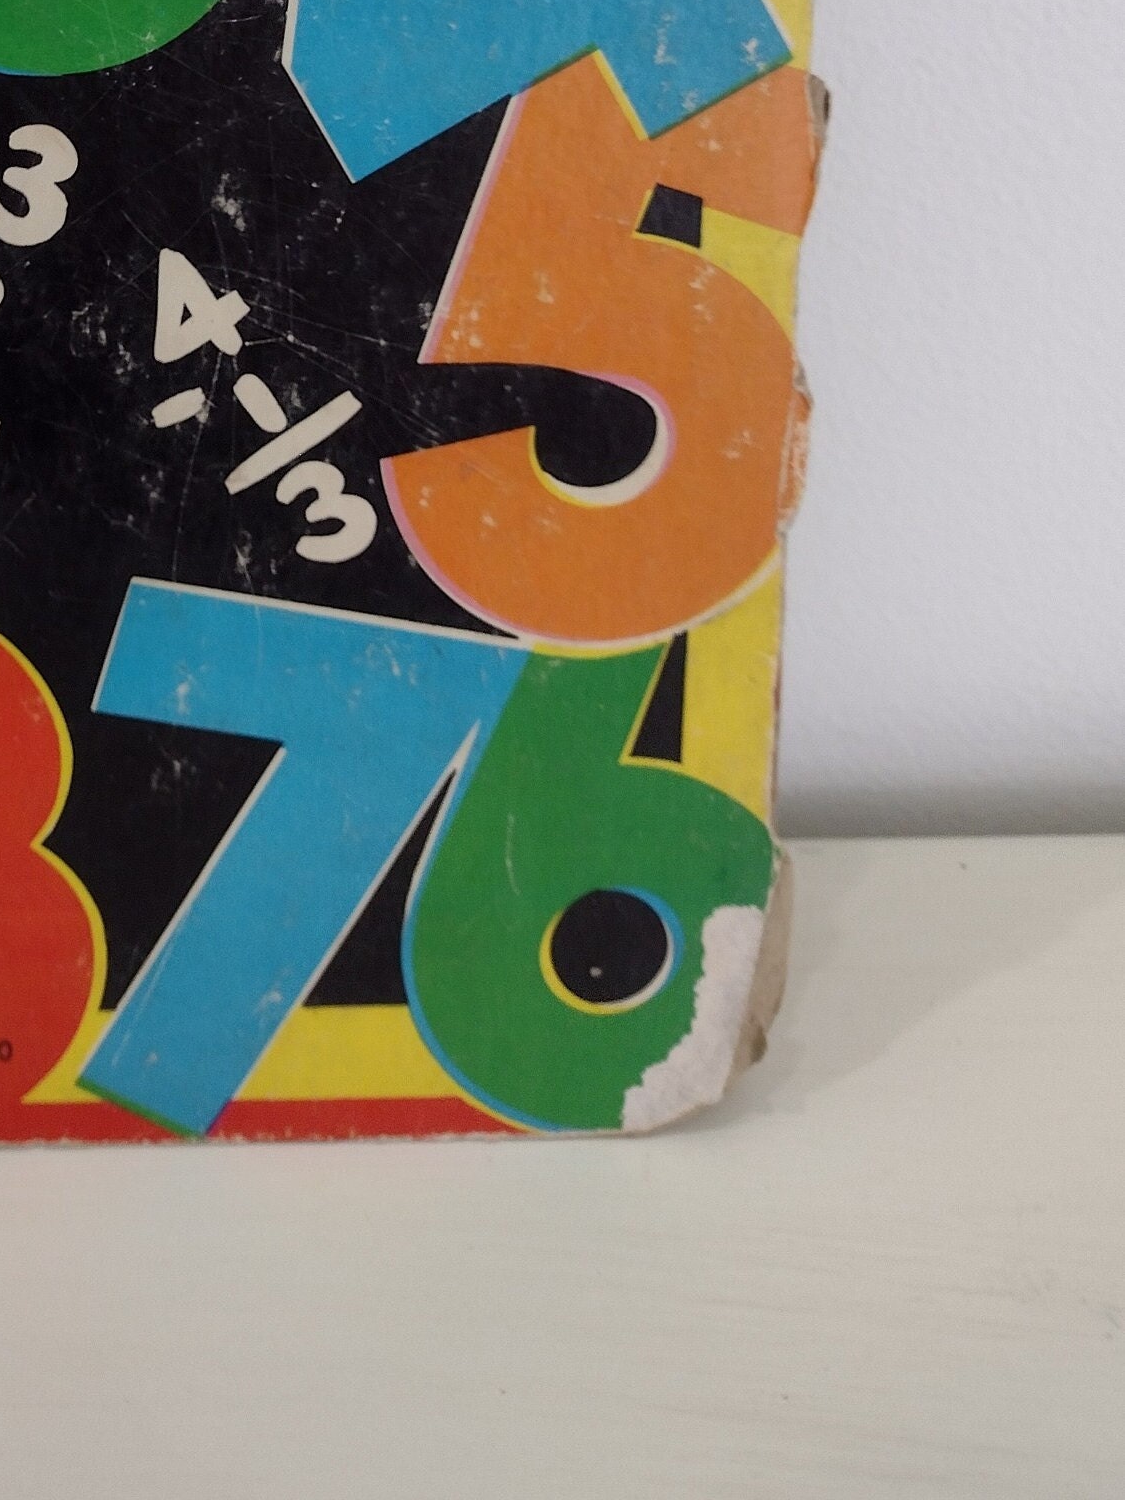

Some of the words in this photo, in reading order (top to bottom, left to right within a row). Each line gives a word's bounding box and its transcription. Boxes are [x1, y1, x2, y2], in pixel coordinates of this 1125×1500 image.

[153, 247, 251, 364] 4
[275, 460, 378, 564] 3
[380, 48, 815, 655] 5
[75, 576, 535, 1140] 7
[401, 640, 778, 1134] 6
